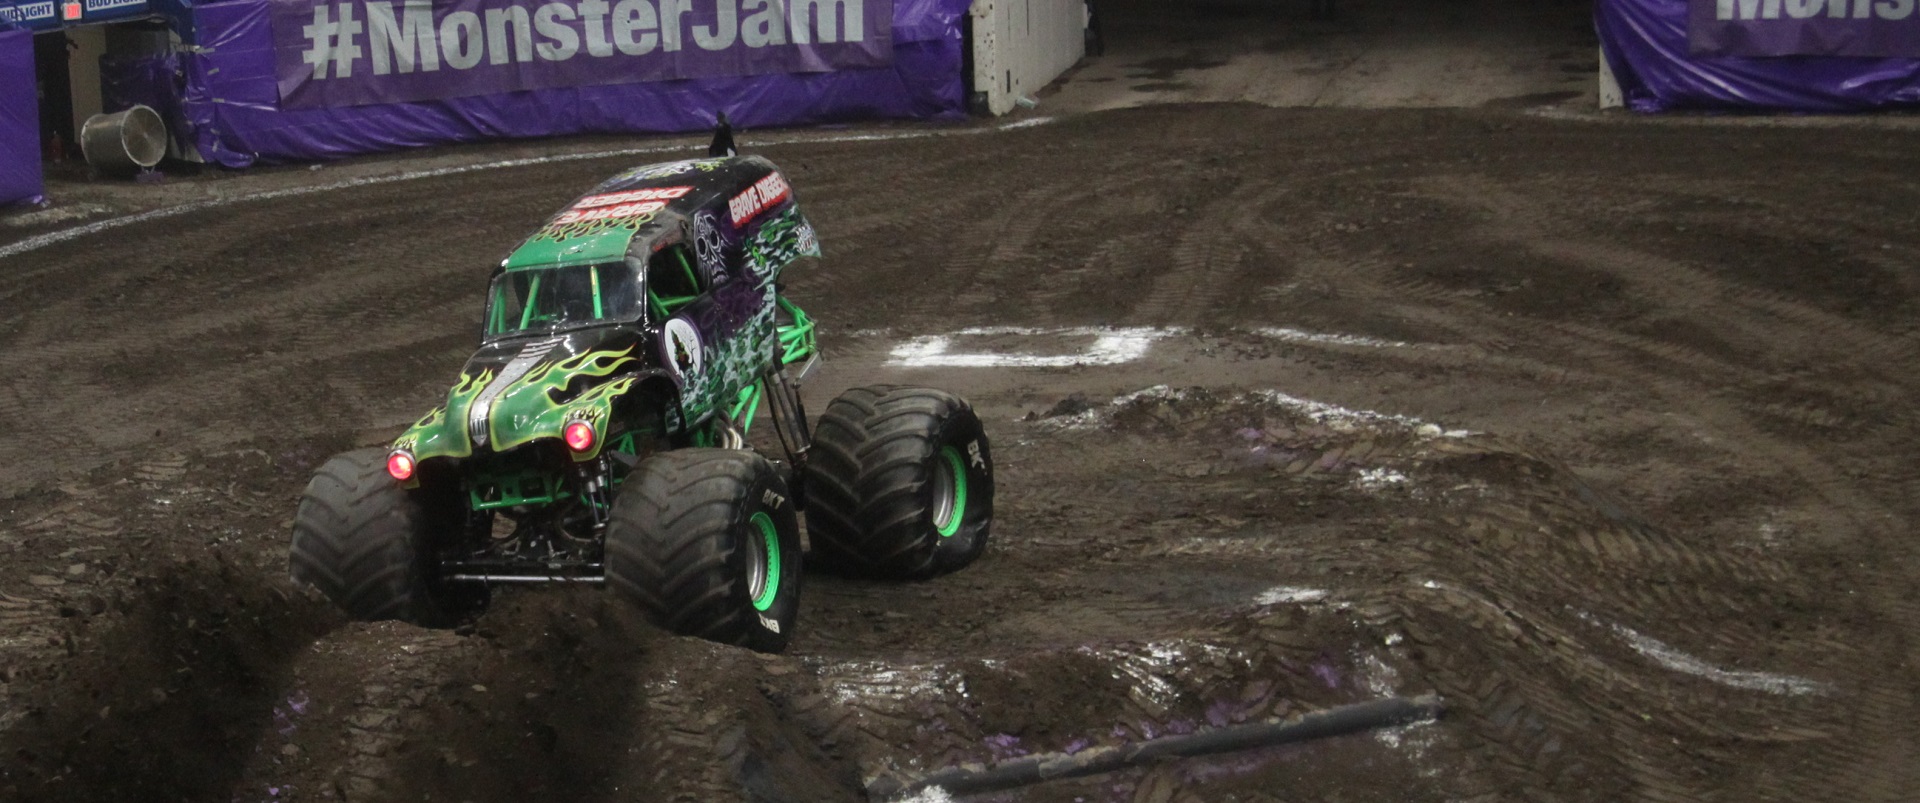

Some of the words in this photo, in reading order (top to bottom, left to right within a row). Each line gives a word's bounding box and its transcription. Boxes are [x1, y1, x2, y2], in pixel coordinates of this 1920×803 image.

[302, 0, 864, 80] #MonsterJam
[572, 186, 692, 209] DIGGER
[728, 185, 761, 223] GRAVE
[754, 171, 790, 204] DIGGER
[554, 200, 665, 225] GRAVE
[762, 488, 785, 510] BKT
